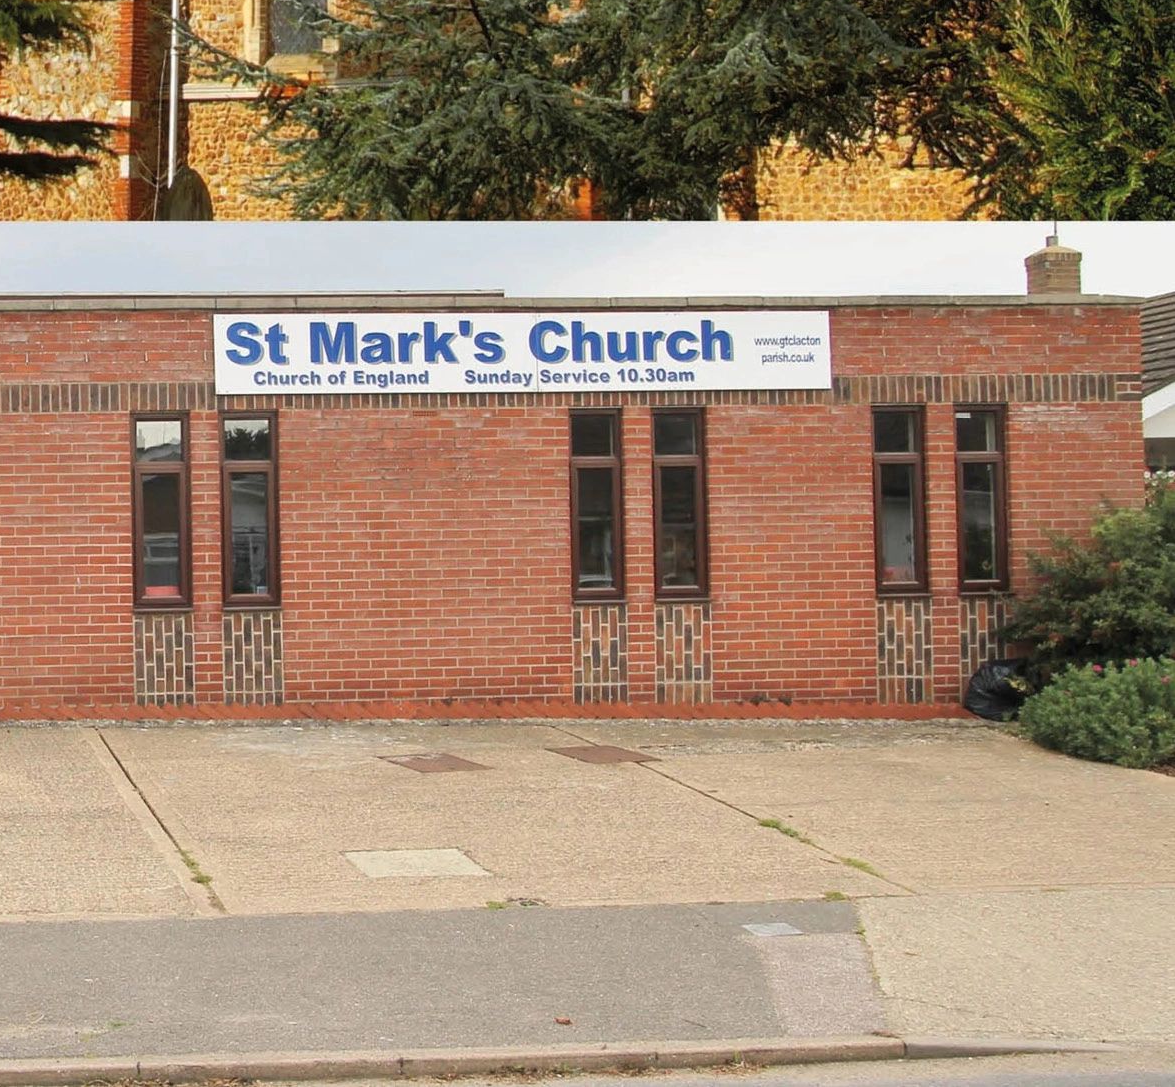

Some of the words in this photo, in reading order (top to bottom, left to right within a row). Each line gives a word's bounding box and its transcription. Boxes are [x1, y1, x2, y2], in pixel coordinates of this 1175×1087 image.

[226, 321, 289, 365] St
[310, 320, 505, 364] Mark's
[528, 319, 734, 364] Church
[753, 335, 821, 349] www.gtclacton
[761, 352, 815, 365] parish.co.uk
[253, 370, 322, 386] Church
[327, 370, 347, 385] of
[353, 370, 430, 388] England
[465, 369, 533, 387] Sunday
[539, 368, 611, 384] Service
[617, 367, 696, 383] 10.30am
